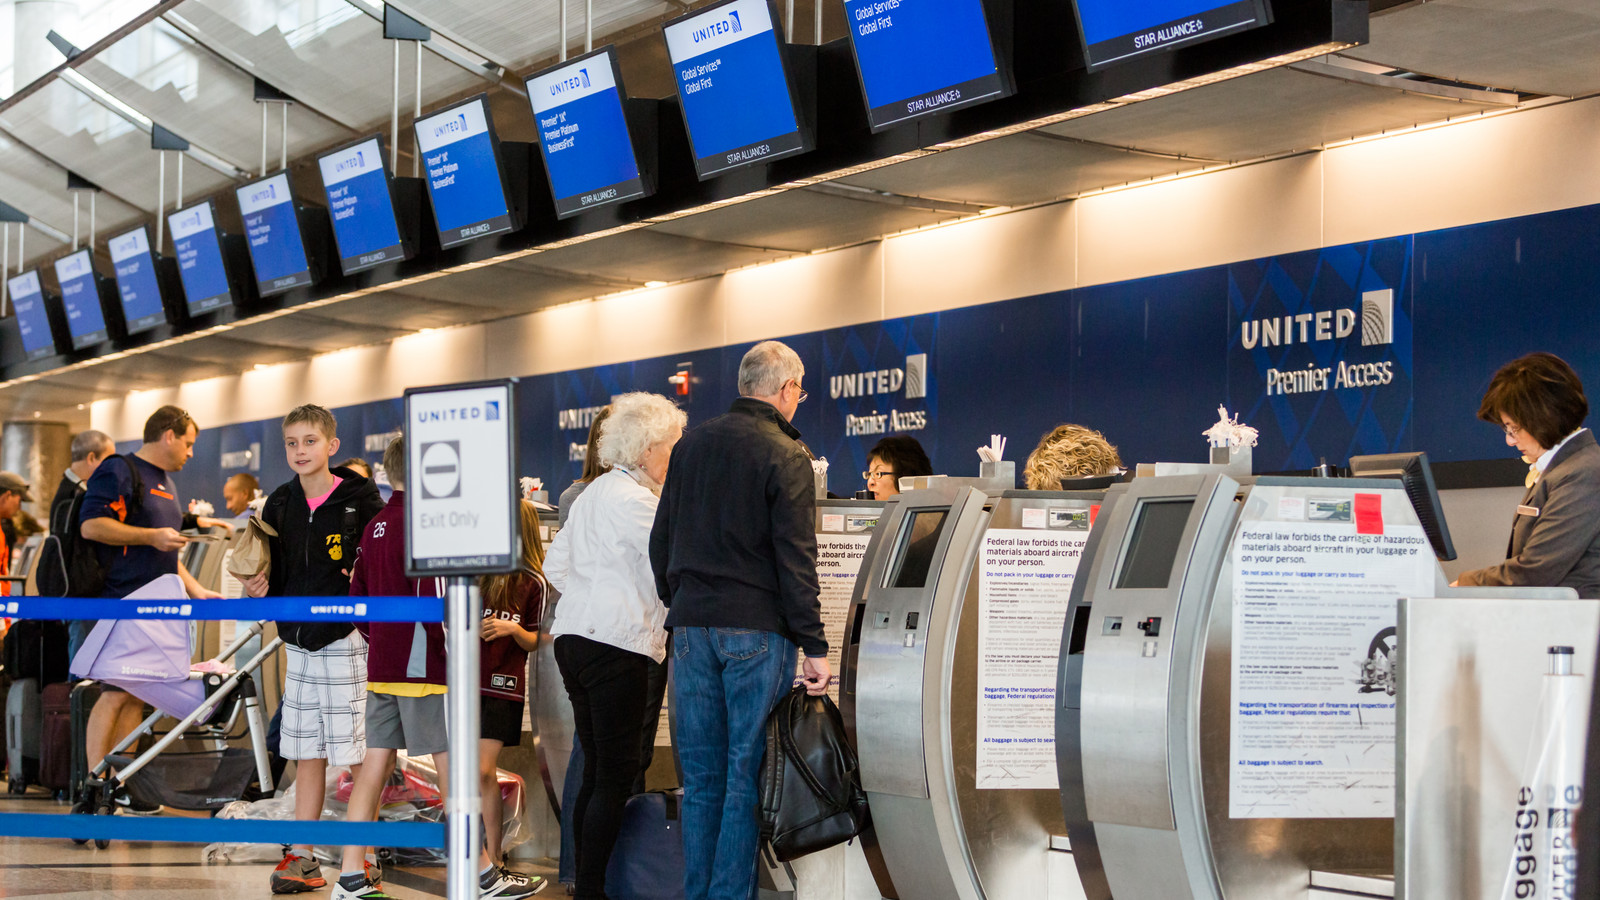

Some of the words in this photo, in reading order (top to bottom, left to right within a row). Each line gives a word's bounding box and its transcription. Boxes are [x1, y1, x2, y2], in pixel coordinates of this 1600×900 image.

[856, 4, 874, 20] Global
[692, 20, 730, 43] UNITED
[859, 20, 878, 36] Global
[878, 15, 892, 30] First
[1134, 32, 1156, 48] STAR
[1158, 20, 1197, 42] ALLIANCE
[682, 66, 697, 81] Global
[550, 77, 580, 96] UNITED
[685, 80, 700, 94] Global
[700, 77, 713, 90] First
[907, 100, 925, 113] STAR
[926, 90, 956, 108] ALLIANCE
[434, 121, 459, 137] UNITED
[544, 128, 560, 141] Premier
[727, 153, 741, 164] STAR
[742, 145, 767, 160] ALLIANCE
[580, 194, 592, 205] STAR
[593, 189, 612, 203] ALLIANCE
[1242, 308, 1356, 350] UNITED
[830, 368, 904, 399] UNITED
[1267, 362, 1332, 396] Premier
[1334, 360, 1393, 389] Access
[418, 407, 480, 423] UNITED
[559, 406, 600, 430] UNIT
[846, 410, 888, 437] Premier
[889, 409, 927, 432] Access
[420, 512, 445, 529] Exit
[449, 510, 480, 528] Only
[373, 522, 386, 538] 26
[1242, 532, 1273, 540] Federal
[1275, 532, 1289, 541] law
[1292, 533, 1321, 542] forbids
[1323, 534, 1336, 542] the
[1383, 535, 1425, 544] hazardous
[987, 538, 1015, 546] Federal
[1017, 538, 1030, 546] law
[1032, 539, 1058, 547] forbids
[1242, 544, 1280, 552] materials
[1282, 544, 1311, 552] aboard
[1314, 545, 1344, 553] aircraft
[1356, 547, 1374, 556] your
[1376, 546, 1407, 556] luggage
[1052, 549, 1078, 557] aircraft
[1255, 556, 1273, 564] your
[1276, 556, 1306, 565] person.
[427, 558, 448, 568] STAR
[449, 556, 488, 567] ALLIANCE
[137, 606, 179, 614] UNITED
[310, 606, 354, 614] UNITED
[484, 608, 520, 623] PIDS
[1515, 786, 1538, 899] ggage
